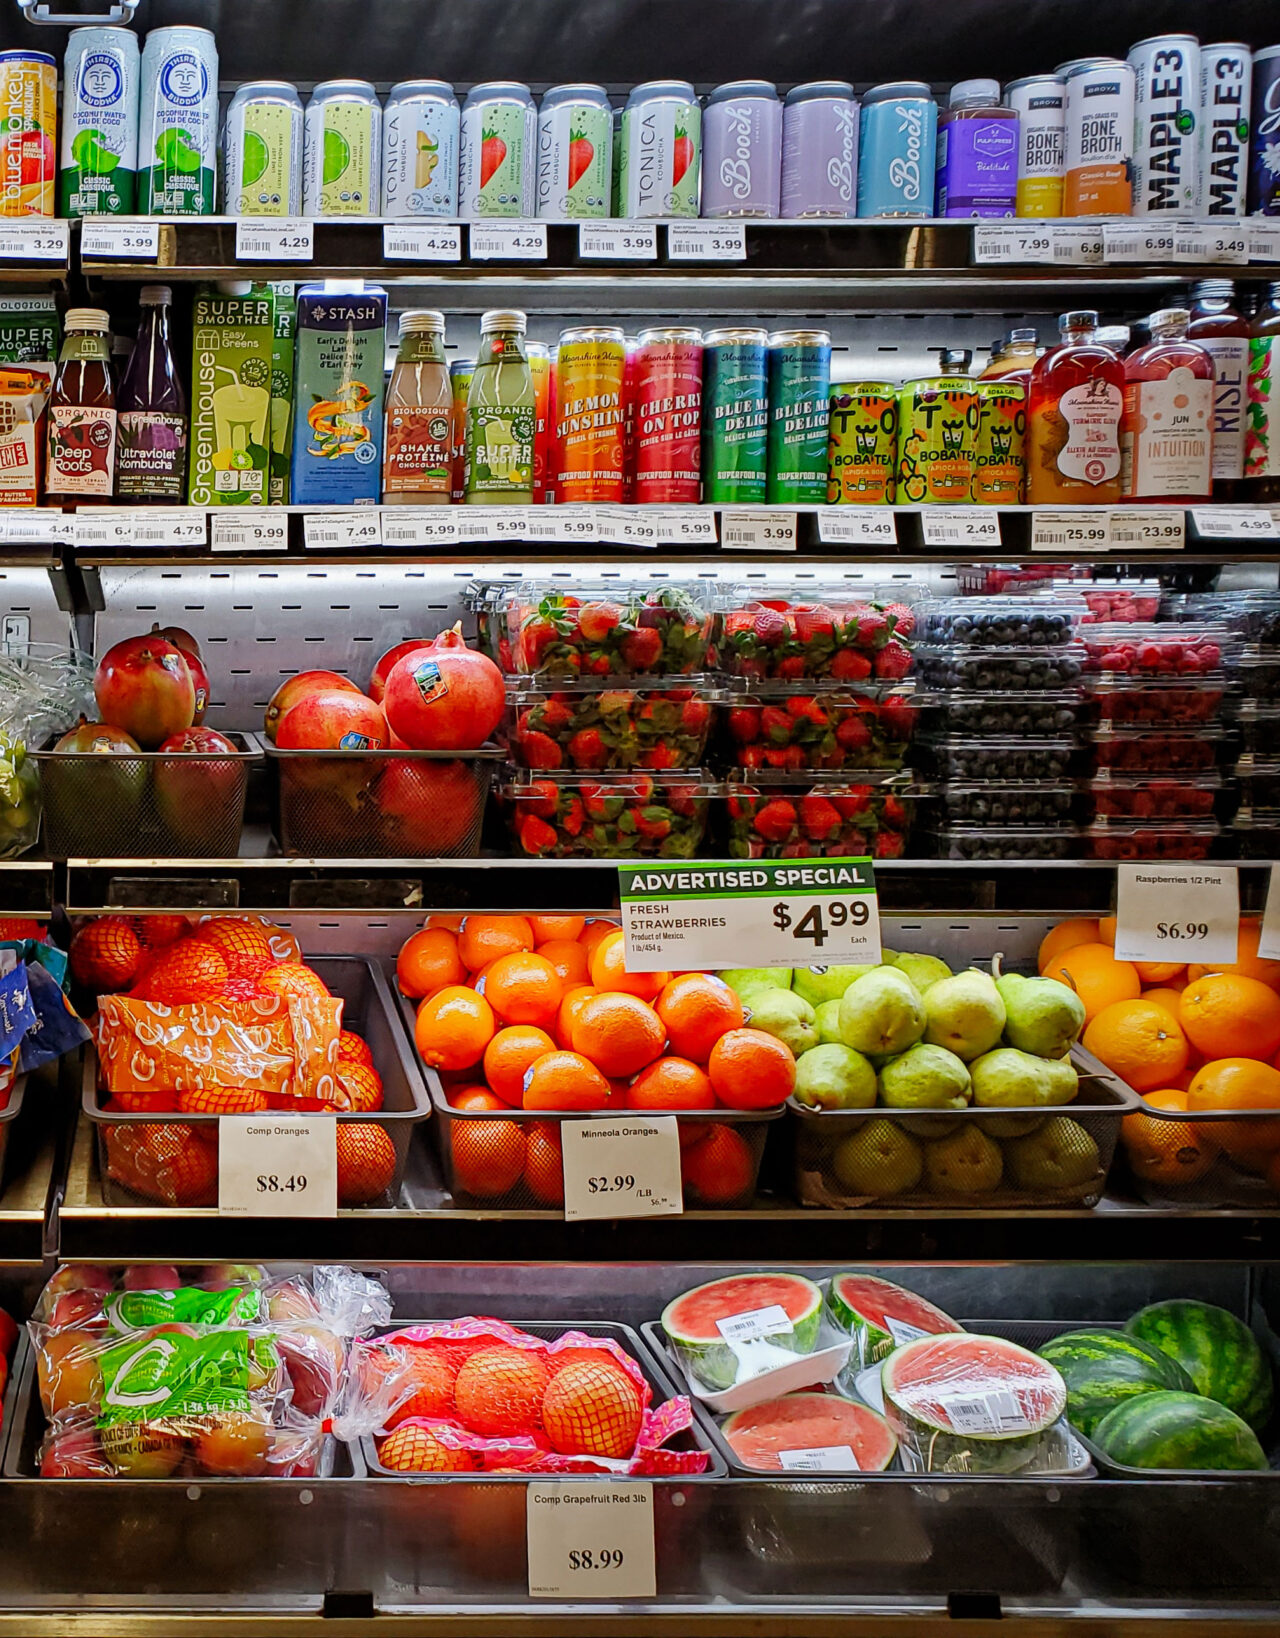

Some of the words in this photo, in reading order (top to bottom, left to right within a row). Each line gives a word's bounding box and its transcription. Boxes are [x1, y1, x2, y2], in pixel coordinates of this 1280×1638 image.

[85, 55, 118, 69] THIRSTY
[83, 93, 119, 106] BUDDHA
[1082, 121, 1116, 138] BONE
[1148, 50, 1183, 210] MAPLE3
[1081, 137, 1122, 155] BROTH
[386, 116, 399, 208] TONICA
[279, 237, 310, 248] 4.29
[623, 239, 653, 248] 3.99
[1019, 239, 1050, 249] 7.99
[197, 301, 269, 315] SUPER
[329, 308, 376, 319] STASH
[197, 315, 269, 325] SMOOTHIE
[222, 330, 246, 341] Easy
[222, 339, 259, 348] Greens
[640, 392, 701, 418] CHERRY
[1214, 369, 1242, 433] RISE
[57, 409, 112, 419] ORGANIC
[644, 418, 667, 435] ON
[671, 413, 700, 430] TOP
[1171, 415, 1190, 426] JUN
[191, 352, 215, 506] Greenhouse
[55, 446, 92, 460] Deep
[120, 448, 176, 460] Ultraviolet
[400, 444, 440, 453] SHAKE
[1148, 441, 1206, 458] INTUITION
[55, 459, 93, 472] Roots
[120, 459, 173, 470] Kombucha
[173, 526, 203, 535] 4.79
[346, 527, 376, 537] 7.49
[763, 528, 793, 538] 3.99
[1066, 529, 1105, 540] 25.99
[630, 870, 768, 891] ADVERTISED
[774, 868, 865, 886] SPECIAL
[1136, 875, 1187, 884] Raspberries
[1205, 877, 1221, 885] Pint
[630, 904, 669, 914] FRESH
[631, 917, 726, 930] STRAWBERRIES
[631, 932, 654, 941] Product
[663, 932, 685, 940] Mexico.
[1156, 922, 1208, 940] $6.99
[851, 936, 867, 944] Each
[246, 1127, 272, 1135] Comp
[274, 1127, 310, 1136] Oranges
[581, 1129, 620, 1138] Minneola
[622, 1128, 658, 1136] Oranges
[256, 1175, 307, 1192] $8.49
[588, 1175, 635, 1193] $2.99
[636, 1189, 652, 1197] /LB
[534, 1494, 561, 1506] Comp
[563, 1494, 610, 1505] Grapefruit
[612, 1494, 630, 1503] Red
[632, 1494, 647, 1503] 3lb
[569, 1549, 624, 1570] $8.99
